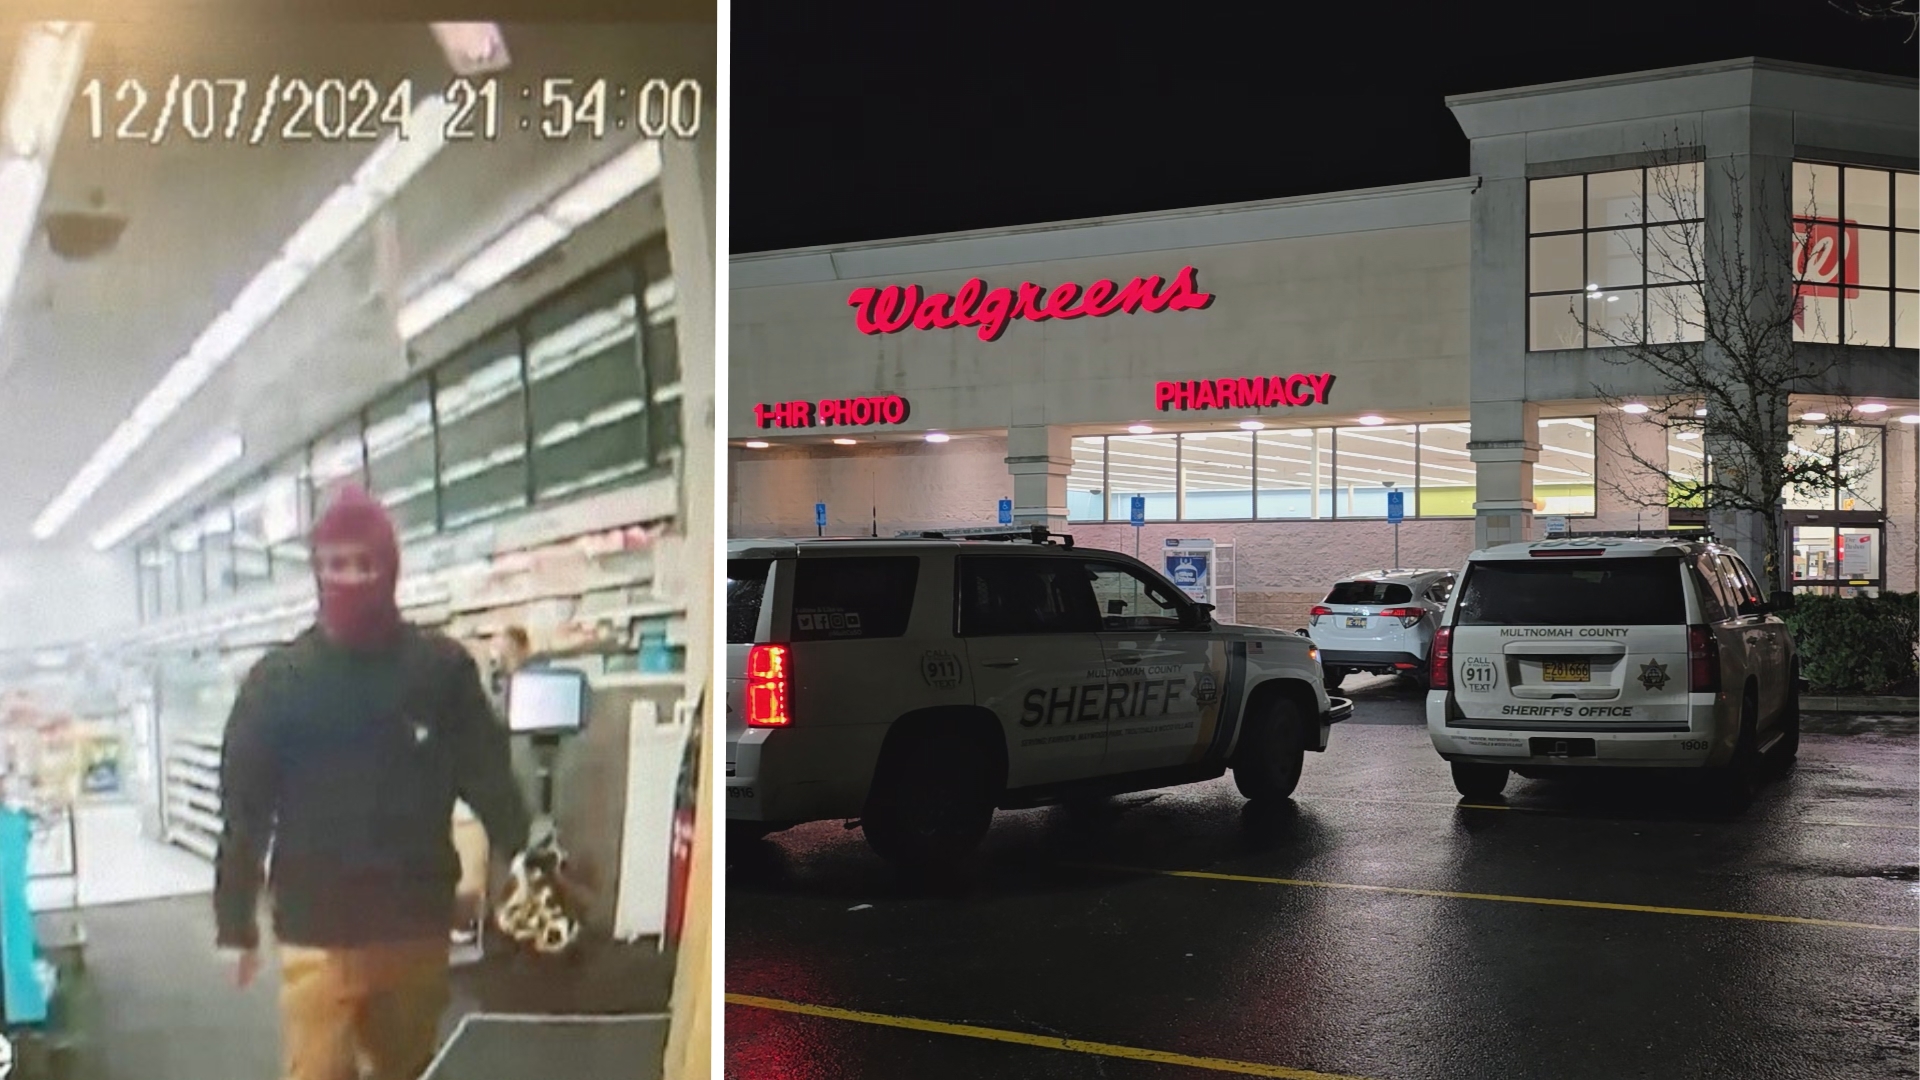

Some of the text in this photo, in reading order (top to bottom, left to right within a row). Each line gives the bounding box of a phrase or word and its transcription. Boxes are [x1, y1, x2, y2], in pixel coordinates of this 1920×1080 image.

[848, 266, 1210, 341] Walgreens
[1155, 373, 1331, 410] PHARMACY
[753, 395, 905, 428] 1-HR PHOTO
[1500, 628, 1629, 637] MULTNOMAH COUNTY
[925, 649, 951, 657] CALL
[927, 661, 955, 677] 911
[1086, 664, 1183, 679] MULTNOMAH COUNTY
[1466, 668, 1491, 681] 911
[932, 679, 956, 688] TEXT
[1469, 683, 1490, 691] TEXT
[1019, 678, 1186, 728] SHERIFF
[1501, 705, 1633, 717] SHERIFF'S OFFICE
[1680, 741, 1709, 750] 1908
[727, 787, 754, 798] 1916
